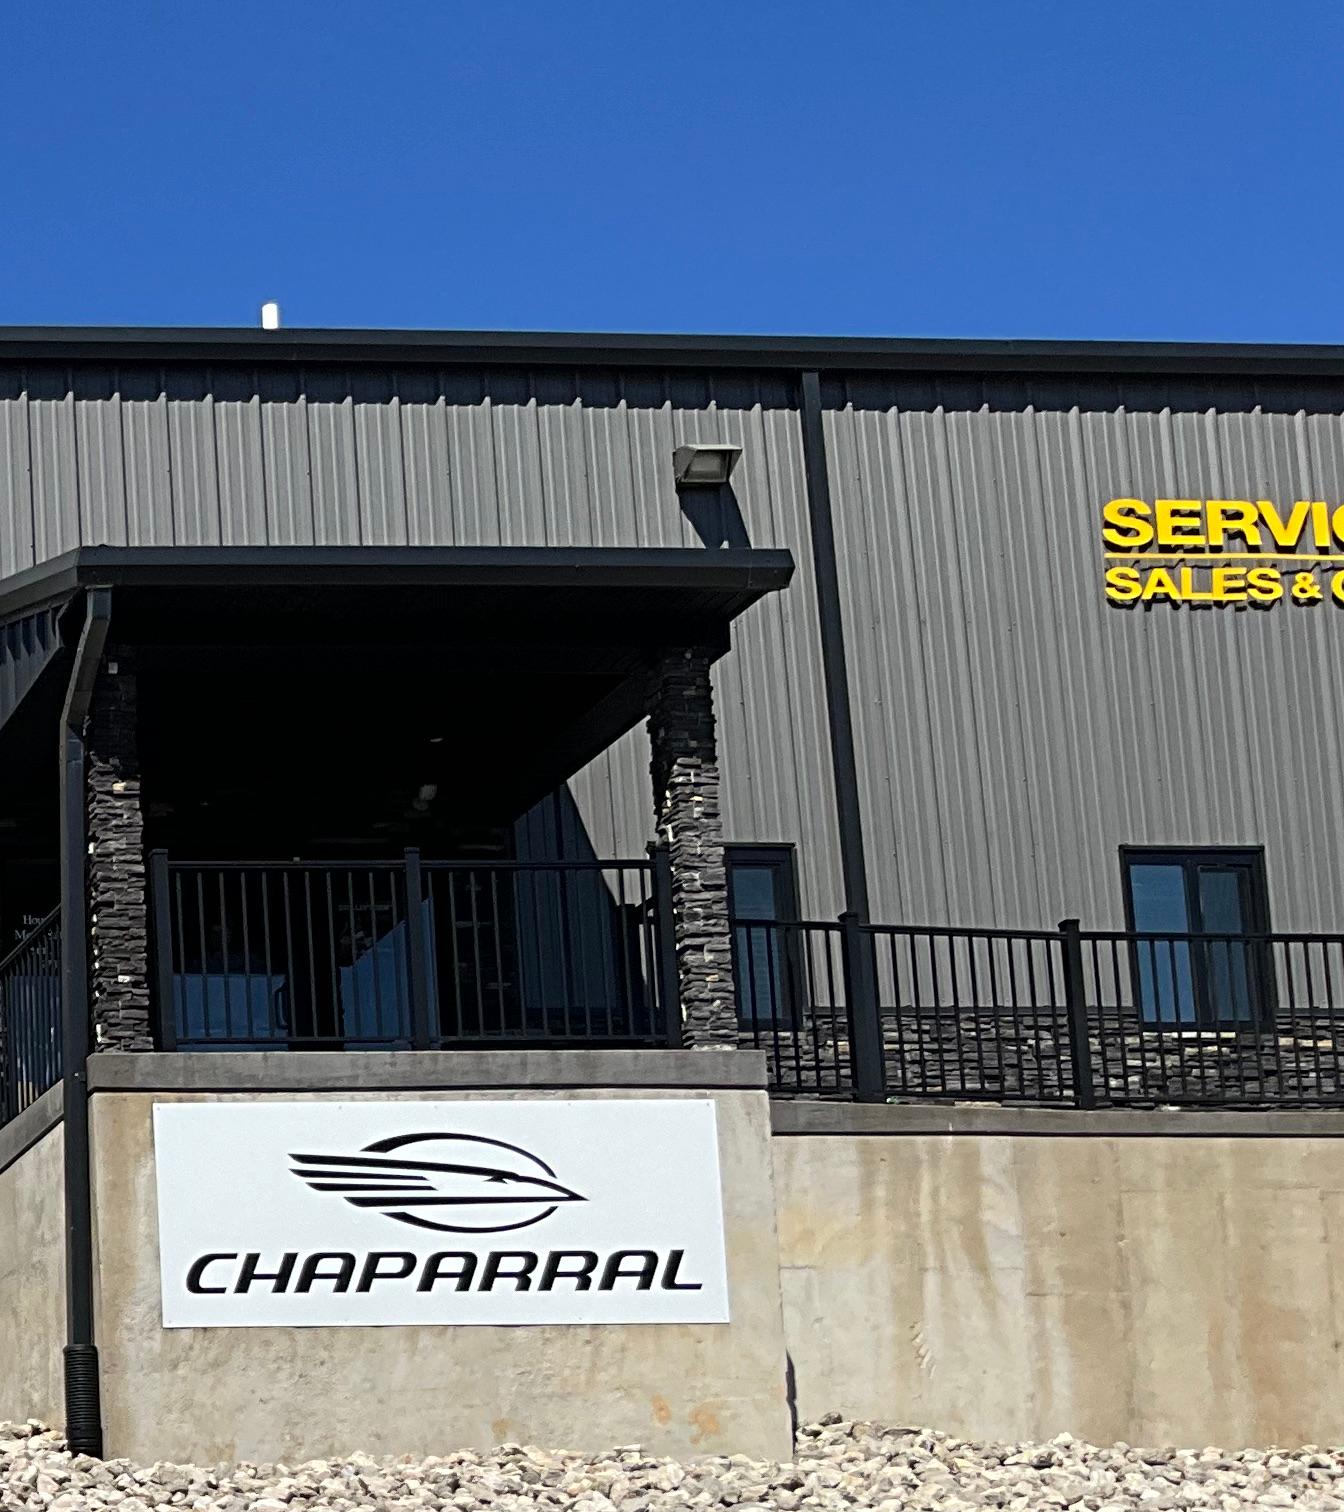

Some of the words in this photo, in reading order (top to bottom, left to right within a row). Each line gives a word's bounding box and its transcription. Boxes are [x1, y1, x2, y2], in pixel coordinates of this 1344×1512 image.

[1102, 498, 1344, 548] SERVI
[1105, 566, 1284, 601] SALES
[1292, 571, 1324, 600] &
[186, 1249, 703, 1294] CHAPARRAL
